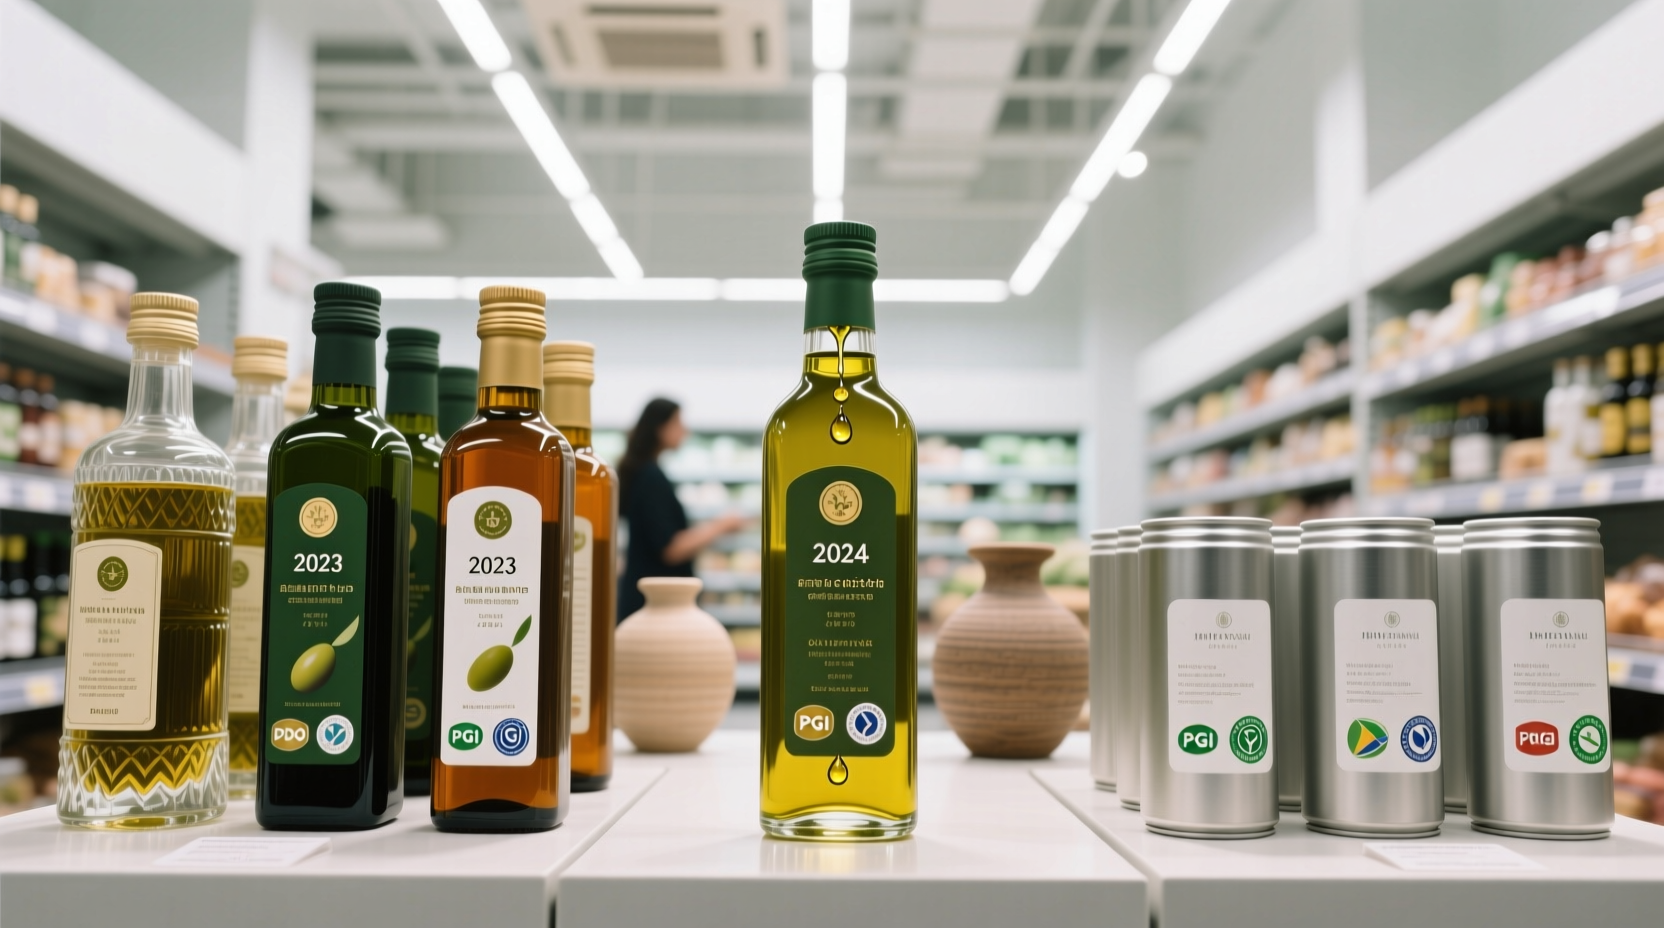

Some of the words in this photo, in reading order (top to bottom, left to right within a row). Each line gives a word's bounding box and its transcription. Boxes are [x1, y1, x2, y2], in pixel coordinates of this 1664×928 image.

[812, 542, 870, 564] 2024
[293, 552, 343, 573] 2023
[468, 556, 517, 575] 2023
[799, 714, 830, 731] PGI
[274, 727, 306, 742] PDO
[452, 729, 479, 744] PGI
[1183, 731, 1214, 749] PGI
